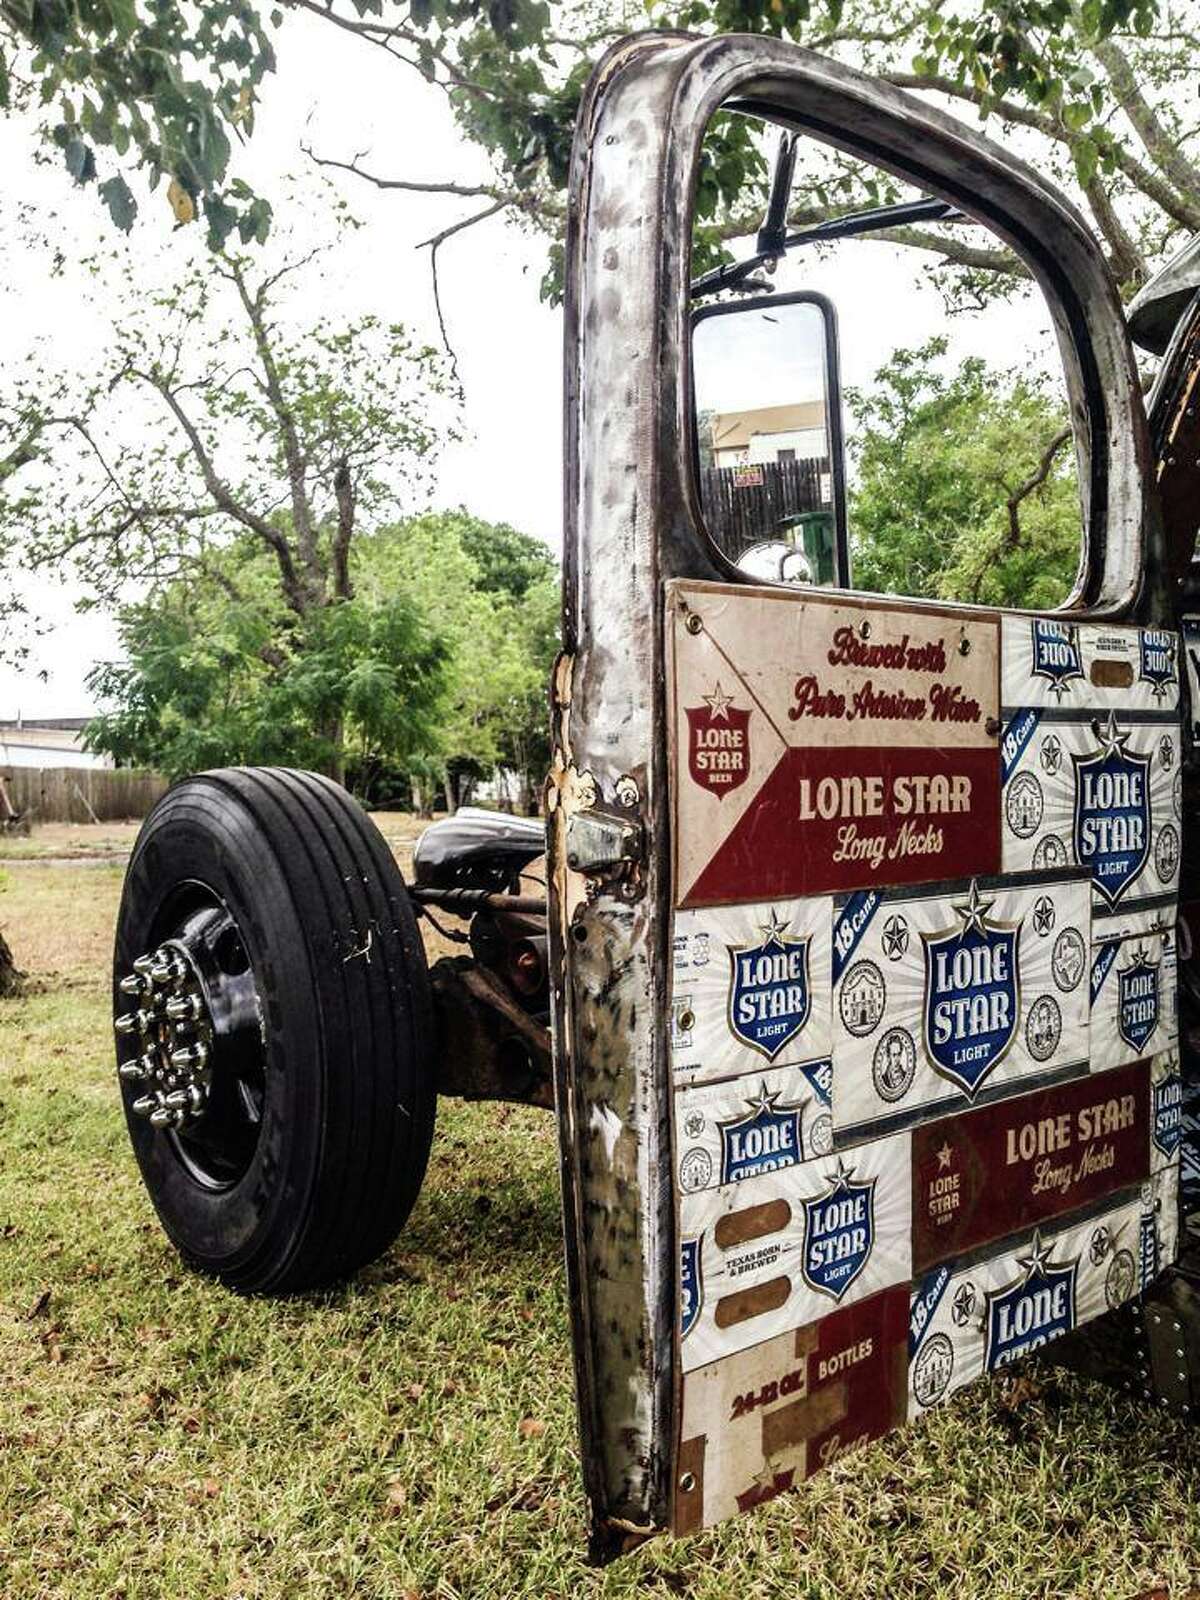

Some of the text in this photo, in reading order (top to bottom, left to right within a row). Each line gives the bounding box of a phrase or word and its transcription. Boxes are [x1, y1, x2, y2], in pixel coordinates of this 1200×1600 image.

[827, 627, 947, 673] Brewed with
[788, 676, 847, 721] Pure
[929, 683, 982, 723] Water
[696, 729, 743, 748] LONE
[1001, 731, 1017, 770] 18
[696, 752, 743, 770] STAR
[799, 775, 972, 820] LONE STAR
[1083, 771, 1142, 810] LONE
[832, 820, 944, 869] Long Necks
[1081, 816, 1146, 856] STAR
[1098, 861, 1128, 876] LIGHT
[834, 891, 876, 962] 18 Cans
[741, 951, 801, 987] LONE
[936, 943, 1008, 993] LONE
[1123, 973, 1155, 1000] LONE
[738, 985, 803, 1024] STAR
[934, 991, 1011, 1044] STAR
[1122, 999, 1155, 1027] STAR
[757, 1023, 788, 1038] LIGHT
[954, 1043, 991, 1065] LIGHT
[730, 1119, 793, 1163] LONE
[1005, 1095, 1136, 1166] LONE STAR
[929, 1173, 961, 1197] LONE
[1031, 1143, 1115, 1195] Long Necks
[812, 1194, 866, 1238] LONE
[928, 1192, 960, 1217] STAR
[726, 1244, 781, 1269] TEXAS BORN
[730, 1254, 778, 1277] & BREWED
[809, 1226, 866, 1271] STAR
[824, 1264, 852, 1282] LIGHT
[910, 1267, 948, 1342] 18 Cans
[997, 1281, 1067, 1345] LONE
[818, 1338, 874, 1381] BOTTLES
